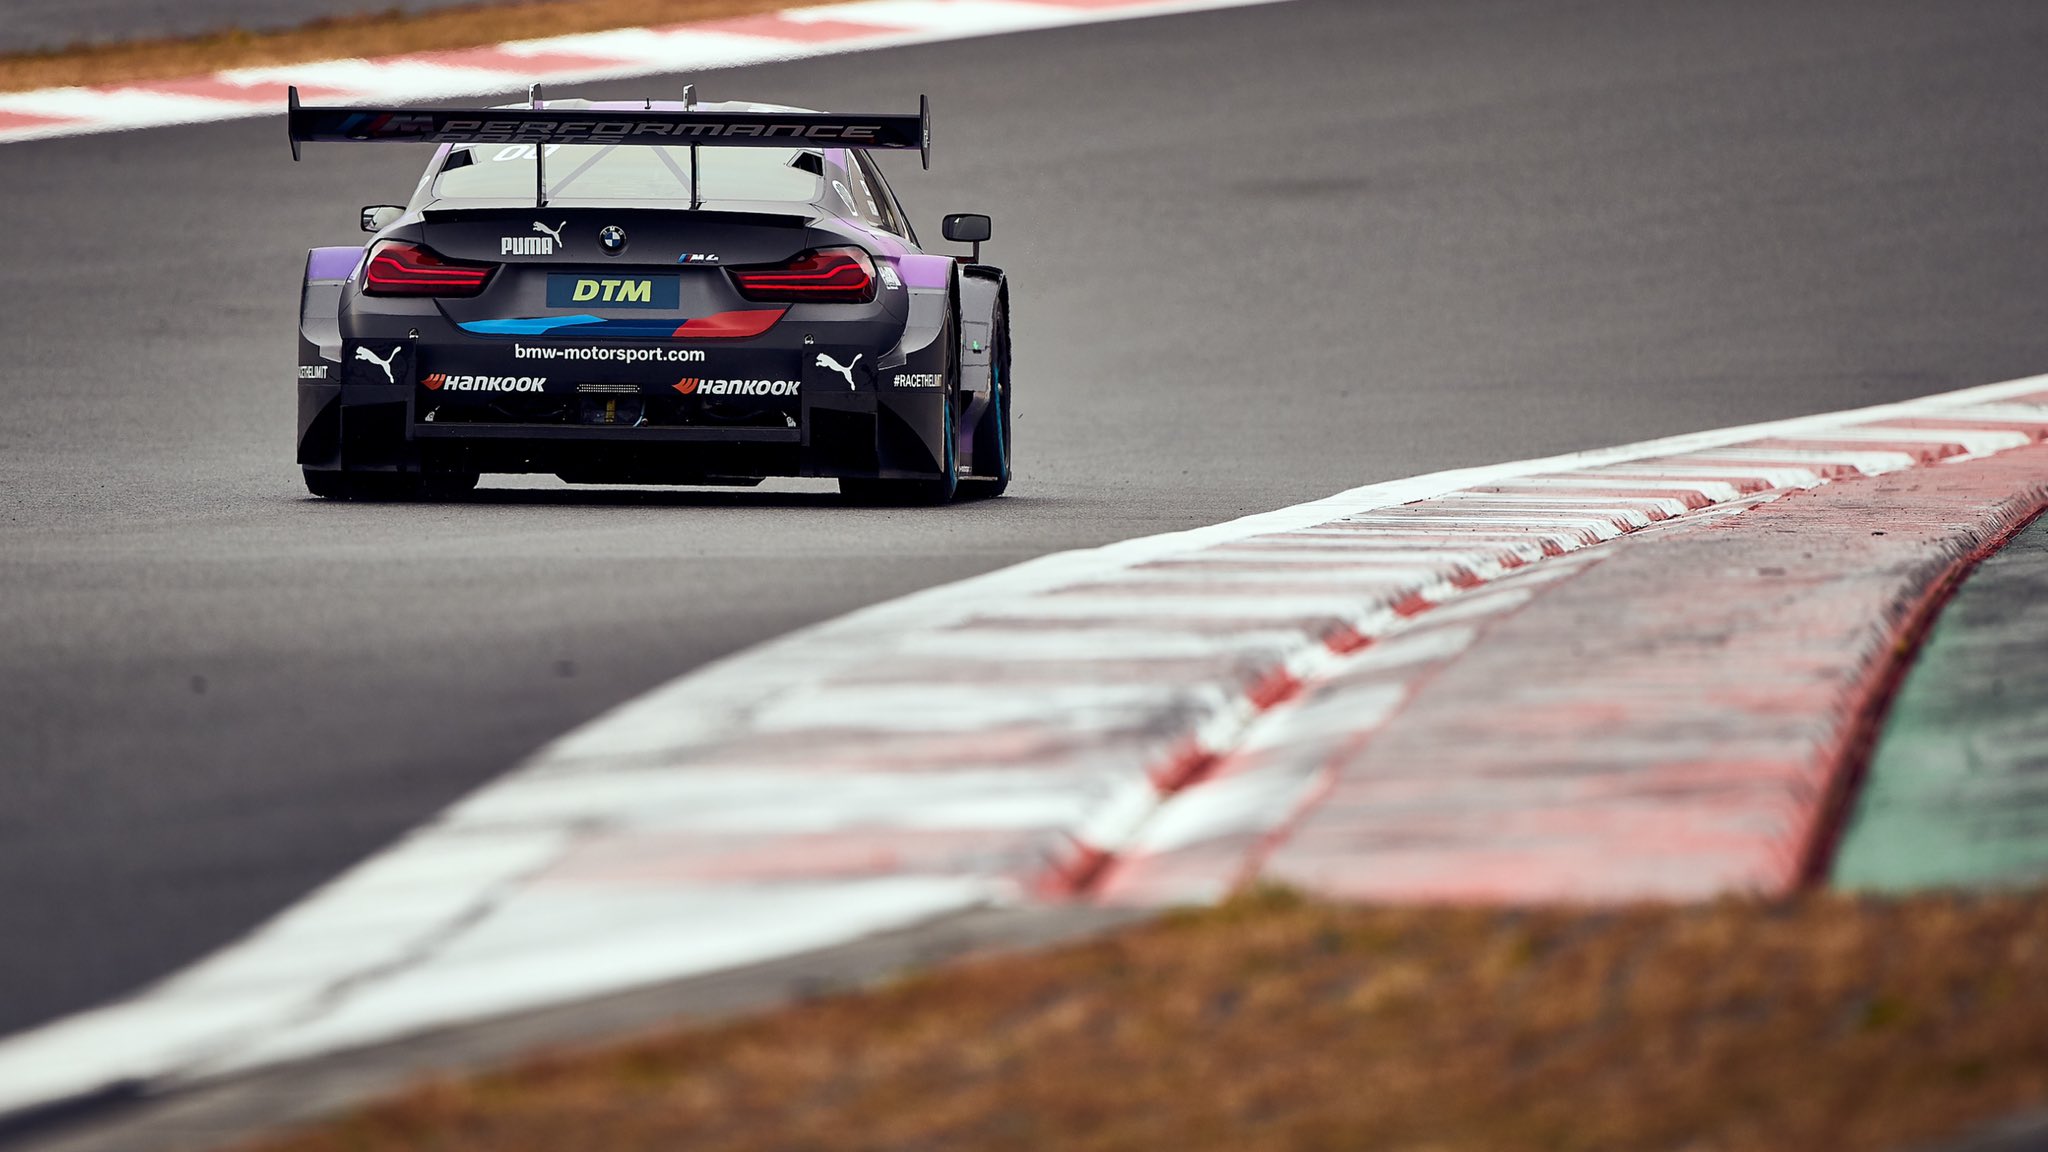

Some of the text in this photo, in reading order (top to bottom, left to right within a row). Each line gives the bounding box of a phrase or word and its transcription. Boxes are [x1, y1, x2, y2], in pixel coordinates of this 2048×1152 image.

[440, 120, 882, 138] PERFORMANCE
[501, 237, 553, 255] PUMA
[572, 279, 652, 302] DTM
[514, 343, 706, 364] bmw-motorsport.com
